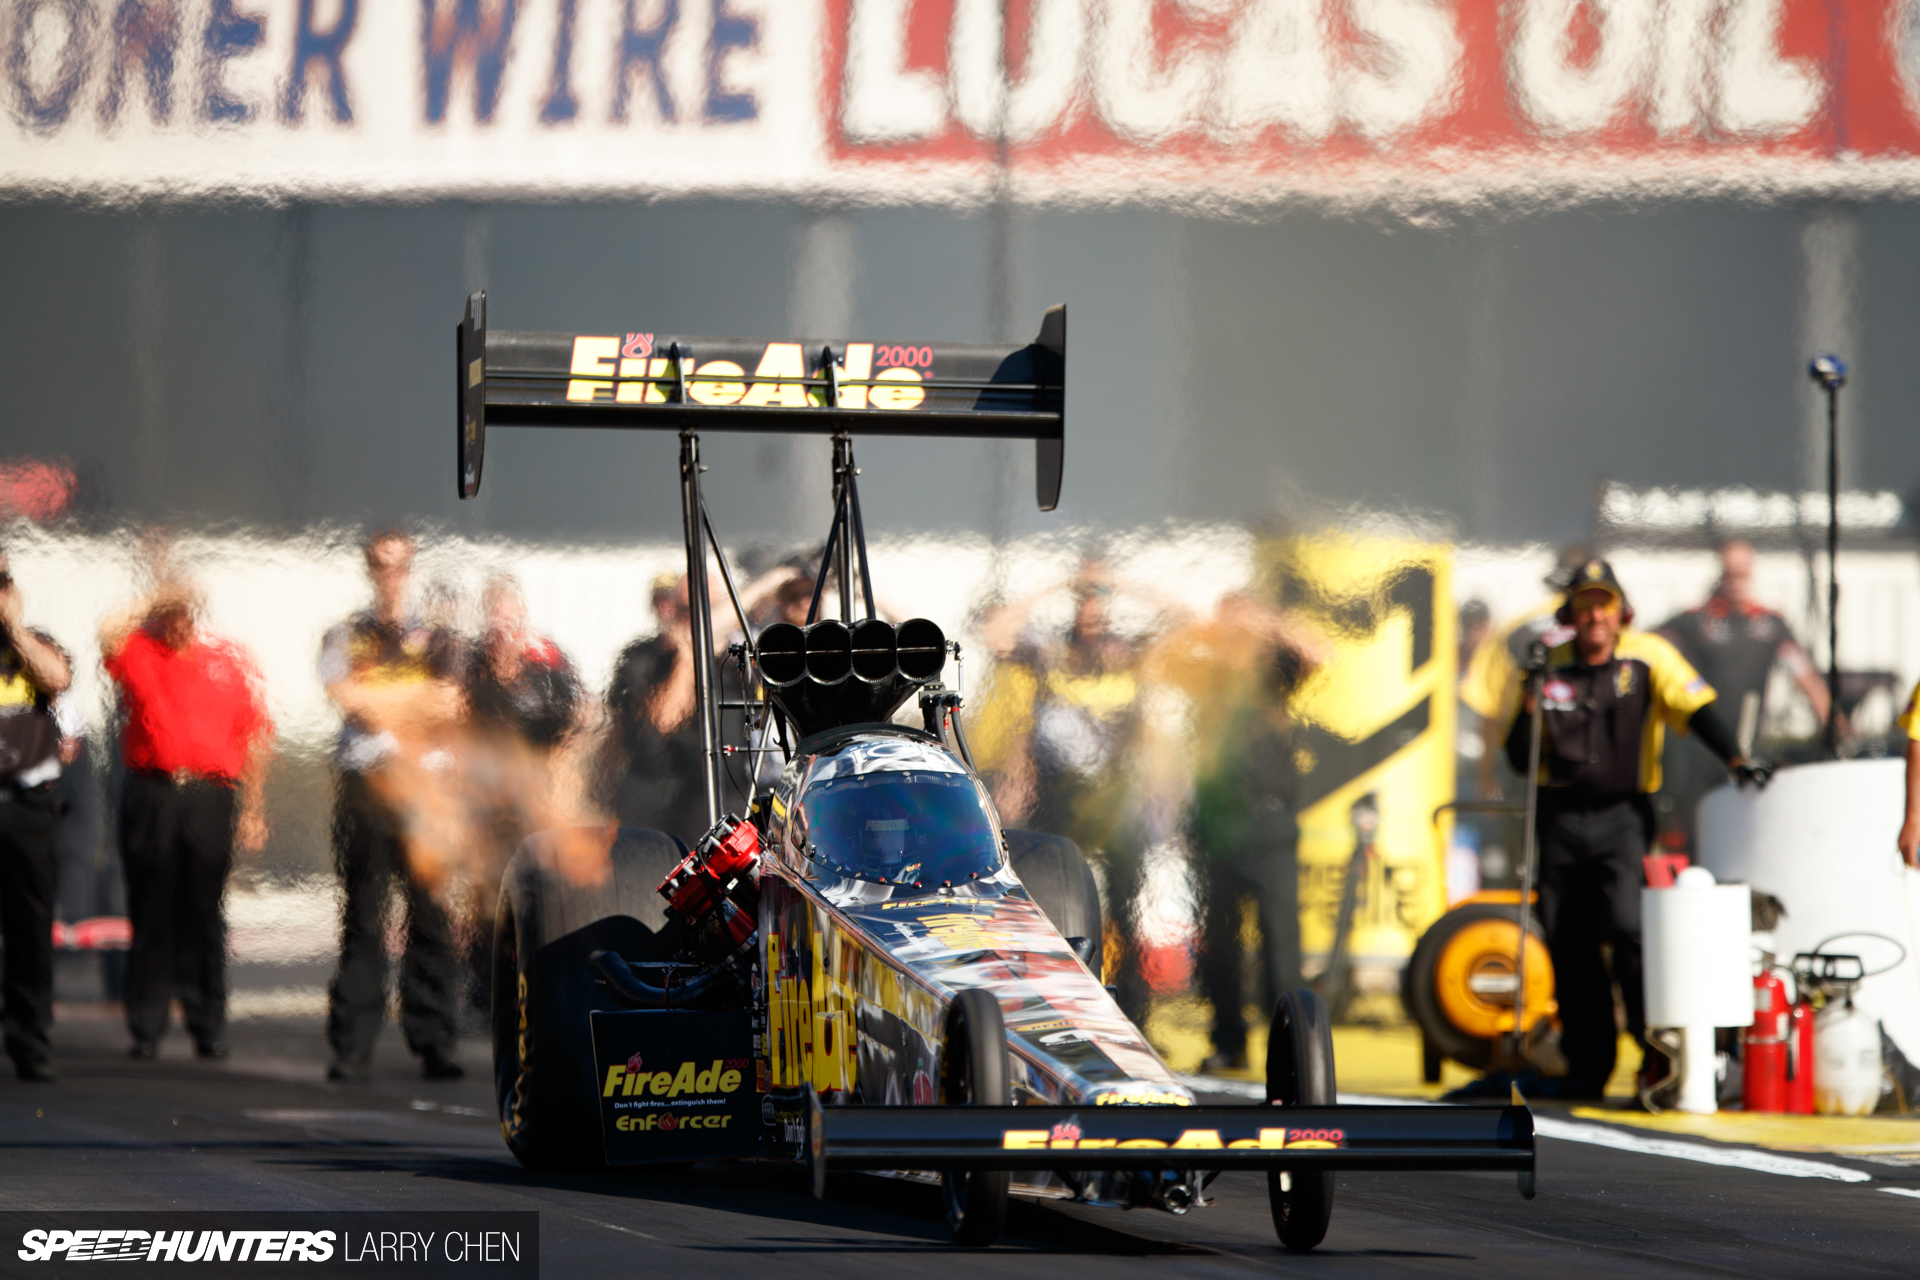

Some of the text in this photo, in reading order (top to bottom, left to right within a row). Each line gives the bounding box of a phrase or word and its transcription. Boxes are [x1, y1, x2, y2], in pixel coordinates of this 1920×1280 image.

[420, 0, 762, 127] WIRE
[841, 0, 1465, 143] LUCAS
[1510, 0, 1827, 142] OIL
[566, 335, 934, 411] FireAde 2000
[602, 1058, 750, 1099] FireAde 2000
[614, 1101, 633, 1109] Don't
[634, 1100, 649, 1110] fight
[706, 1097, 726, 1106] them!
[1288, 1128, 1344, 1142] 2000
